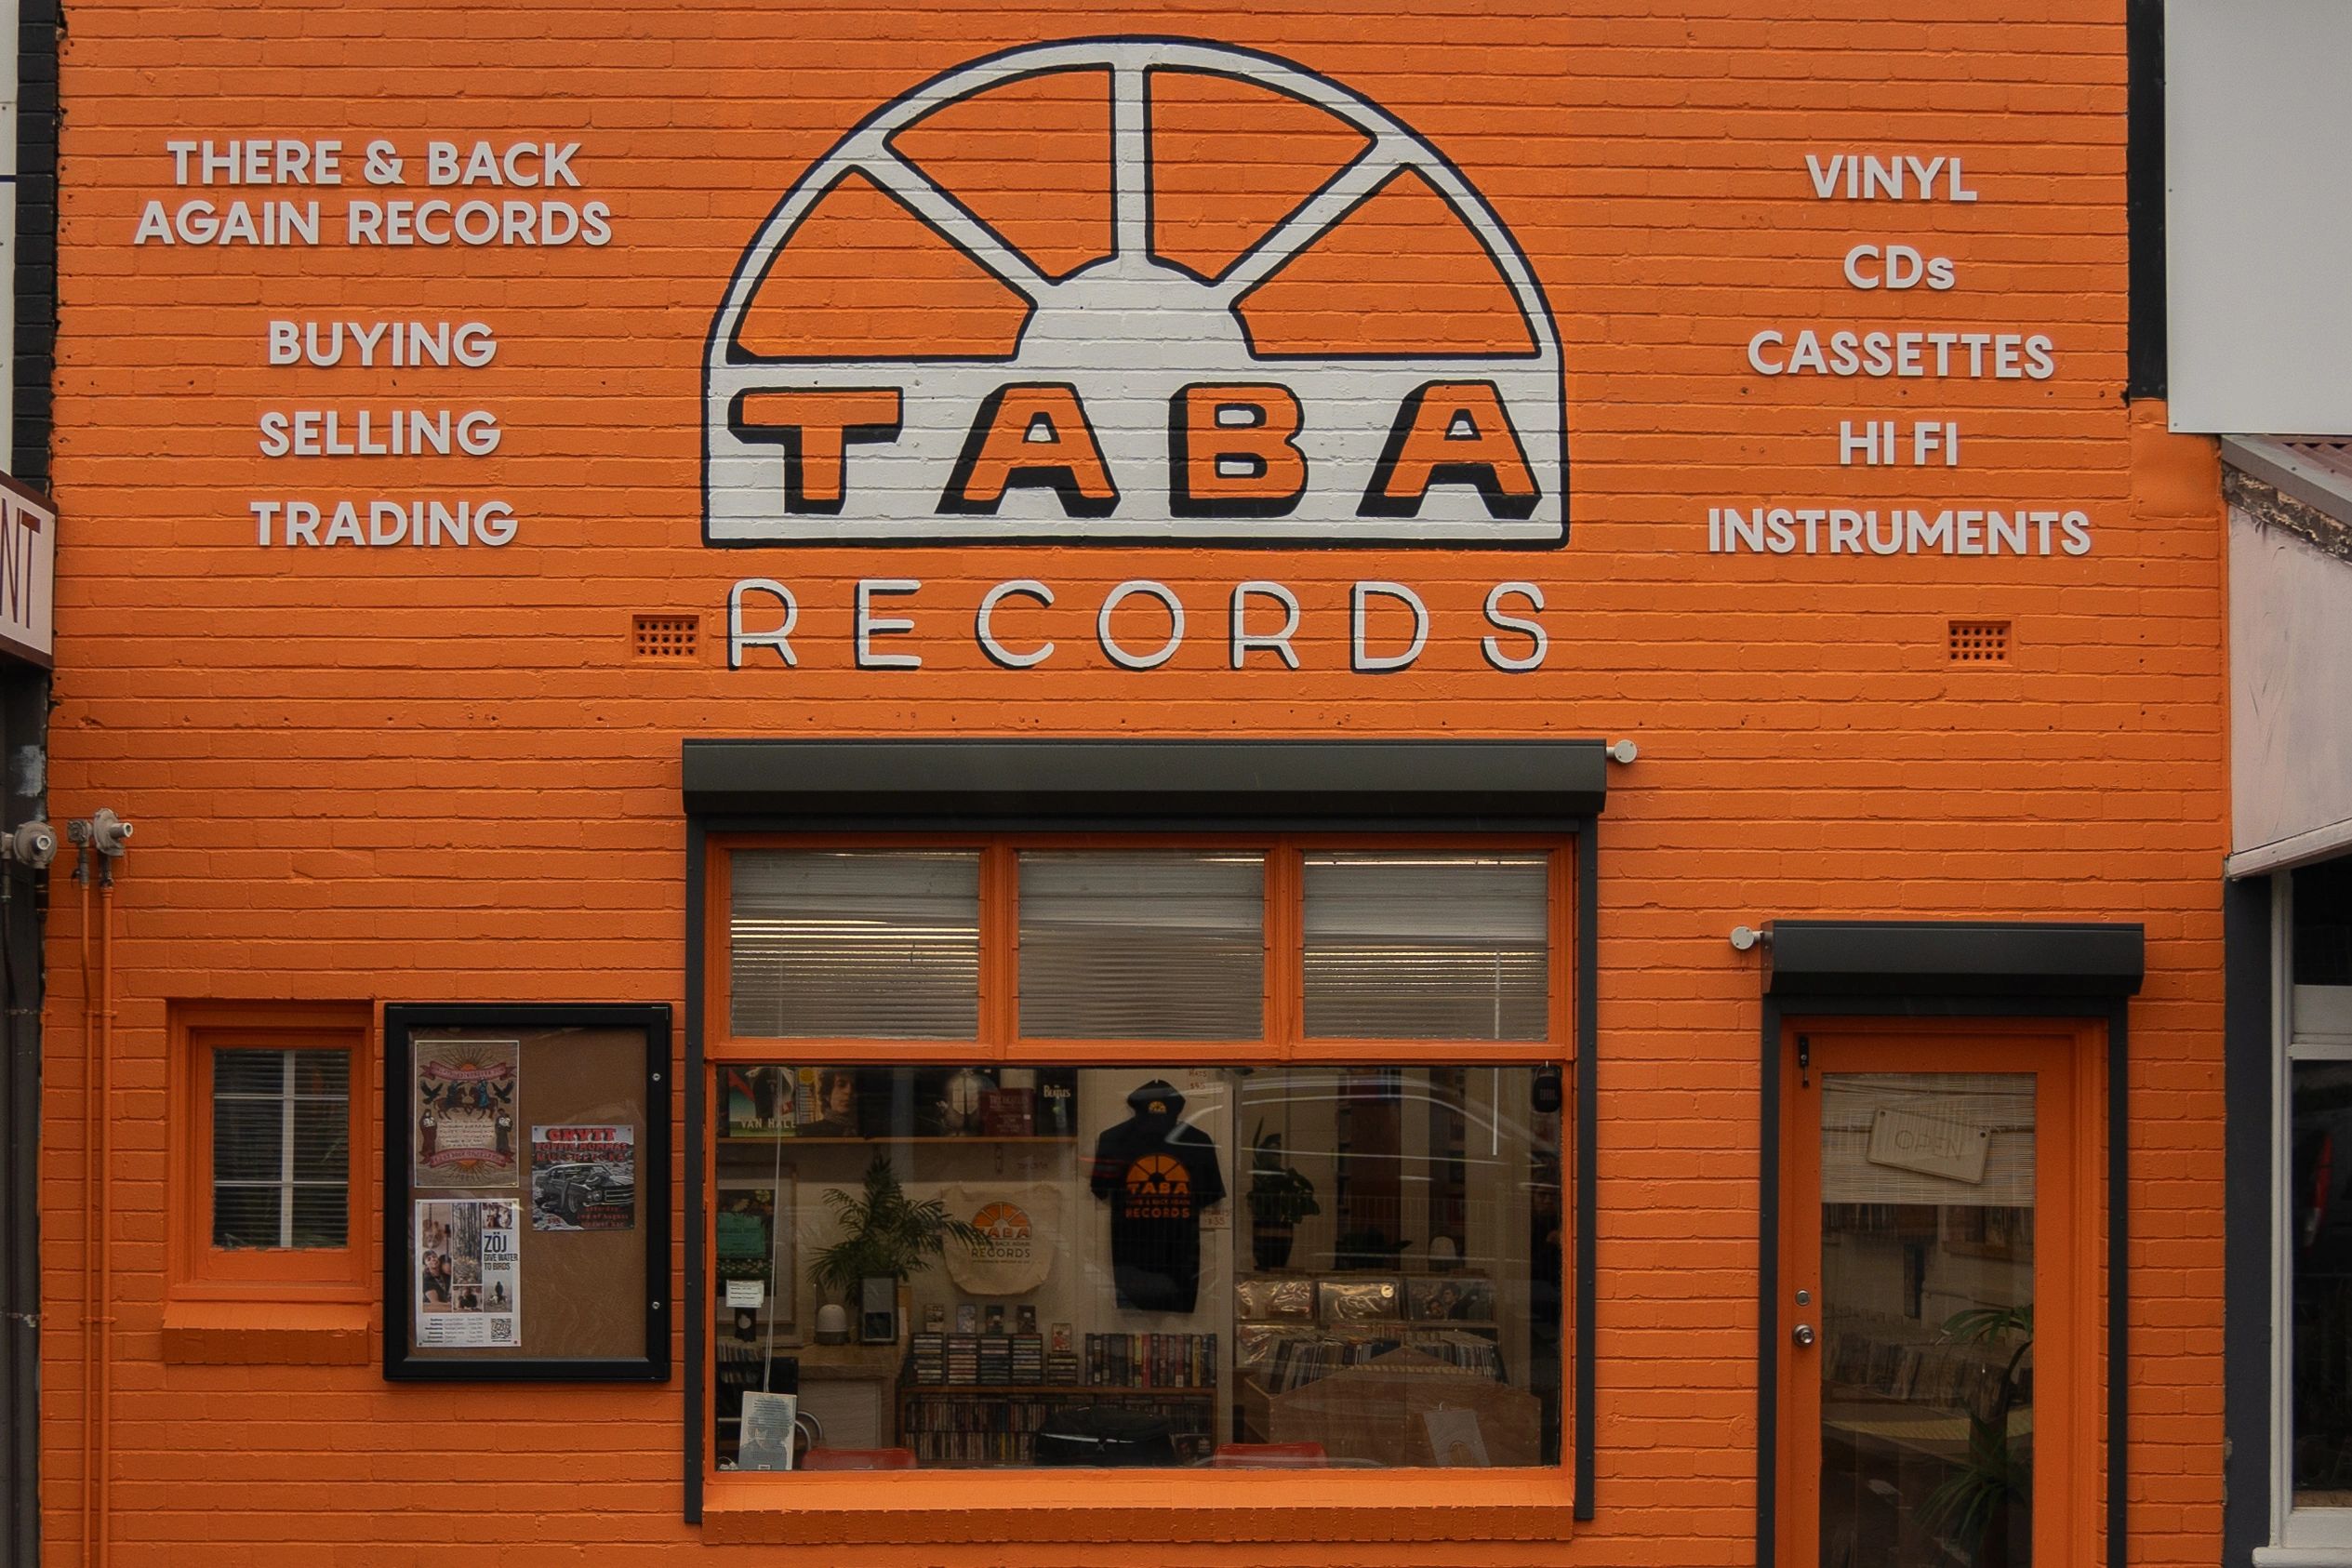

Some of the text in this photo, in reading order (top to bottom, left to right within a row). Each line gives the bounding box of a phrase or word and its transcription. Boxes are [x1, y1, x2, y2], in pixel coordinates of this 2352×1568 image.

[166, 139, 582, 190] THERE & BACK
[1804, 153, 1979, 204] VINYL
[133, 198, 614, 248] AGAIN RECORDS
[1842, 243, 1957, 292] CDs
[267, 319, 498, 369] BUYING
[1746, 329, 2056, 381] CASSETTES
[259, 408, 503, 458] SELLING
[727, 379, 1543, 520] TABA
[1838, 419, 1960, 468] HI FI
[247, 498, 520, 549] TRADING
[1707, 507, 2093, 558] INSTRUMENTS
[728, 578, 1549, 671] RECORDS
[740, 1118, 763, 1129] VAN
[1895, 1130, 1963, 1161] OPEN
[1125, 1207, 1190, 1219] RECORDS
[1126, 1182, 1190, 1195] TABA
[484, 1231, 507, 1253] ZÖJ
[971, 1248, 1030, 1258] RECORDS
